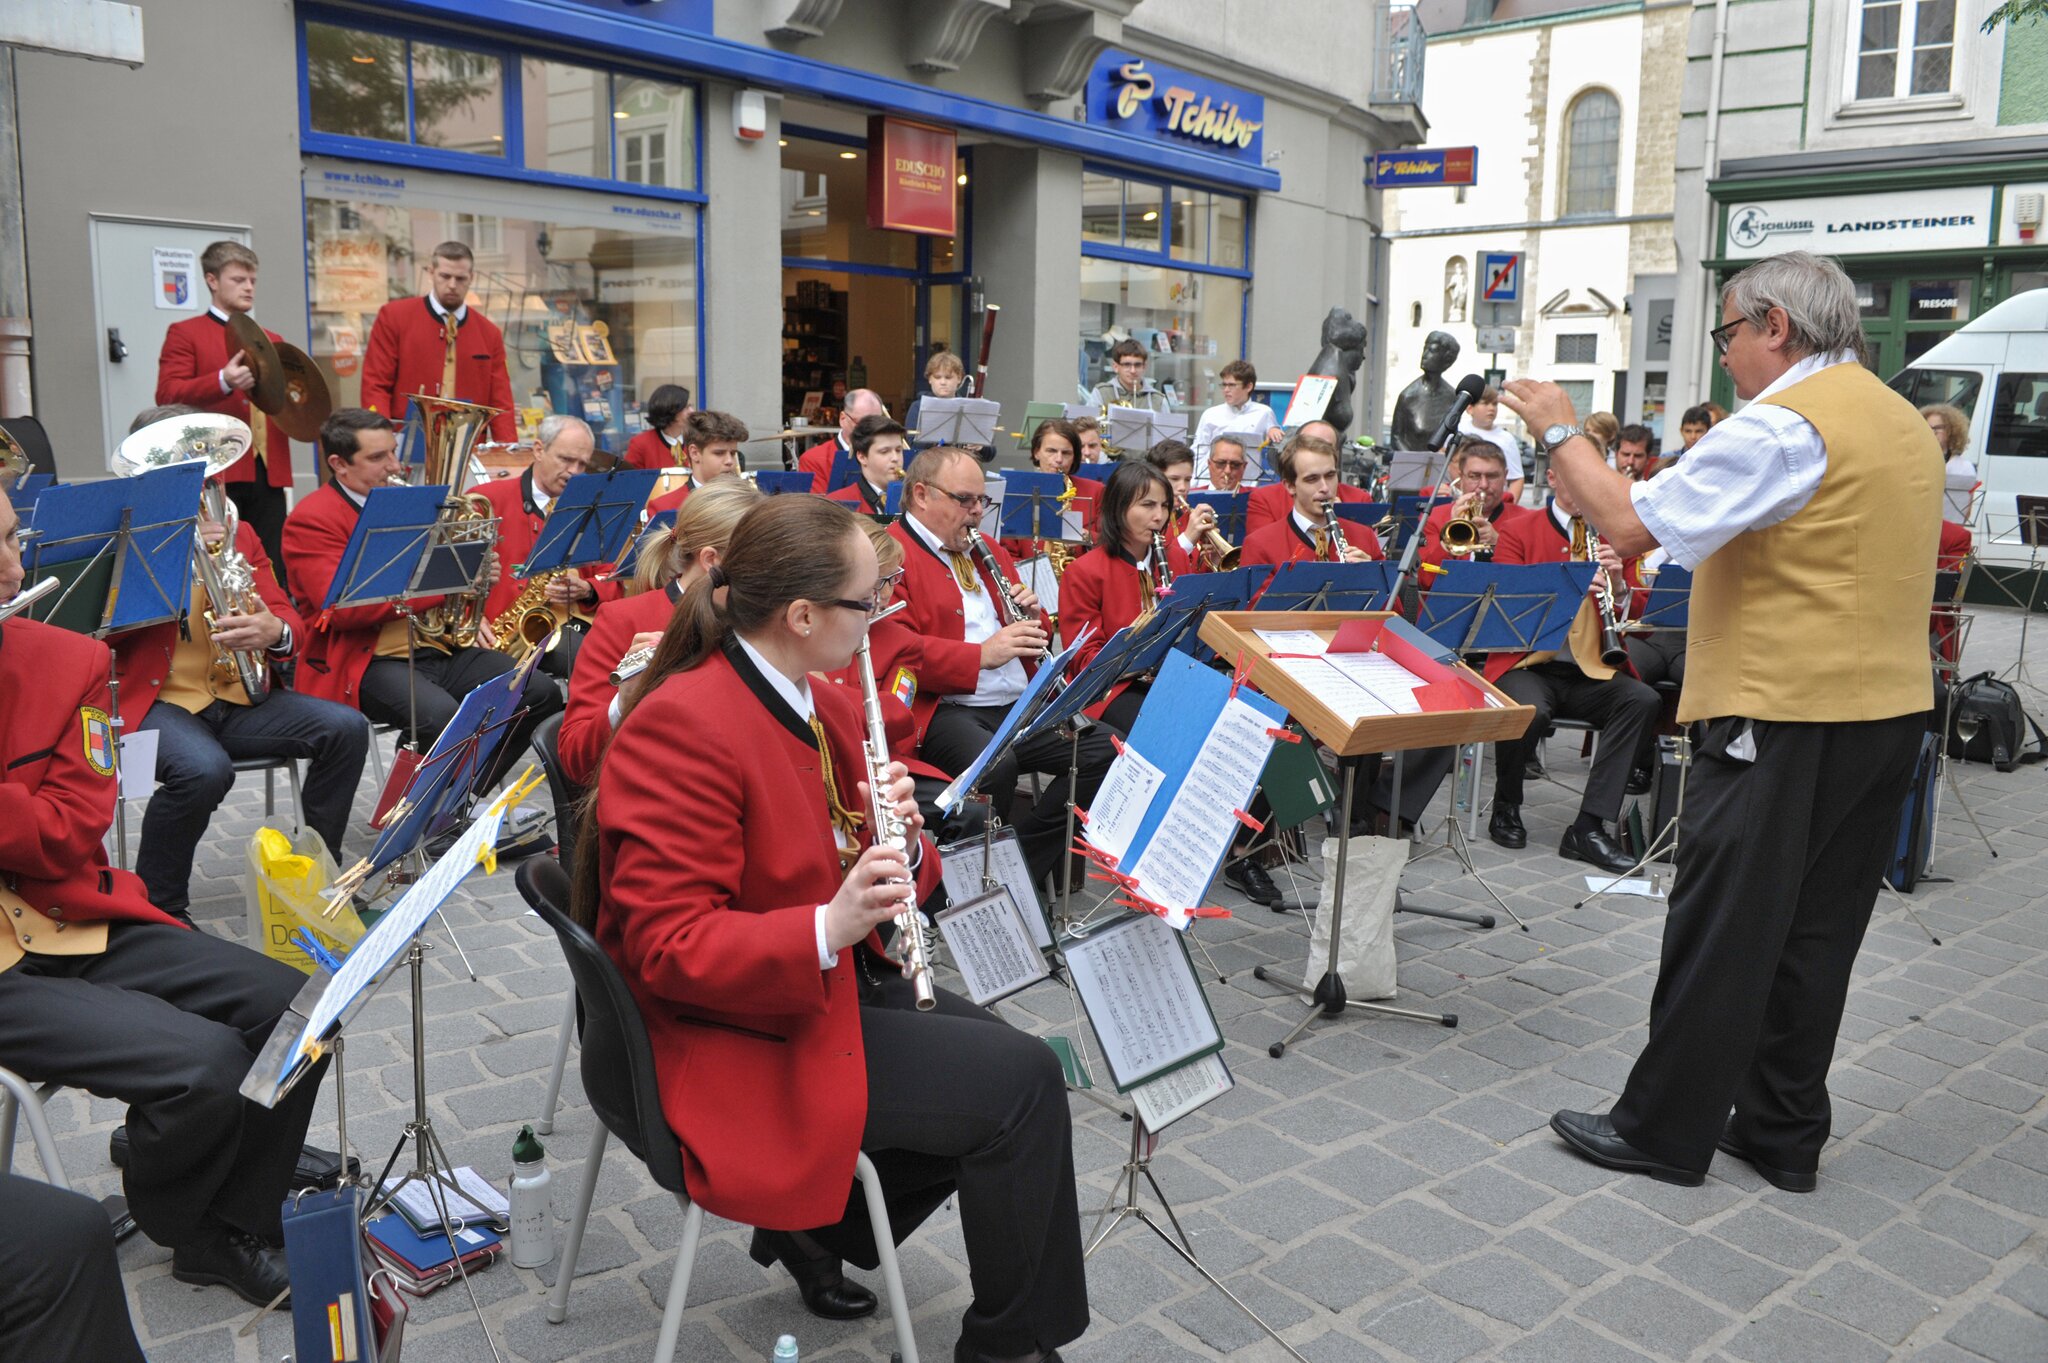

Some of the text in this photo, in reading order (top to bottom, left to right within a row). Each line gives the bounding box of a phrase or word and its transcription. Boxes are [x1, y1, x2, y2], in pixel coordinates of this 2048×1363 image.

[1164, 86, 1263, 149] Tchibo
[895, 158, 945, 178] EDUSCHO
[1394, 161, 1441, 176] Tchibo
[324, 171, 405, 189] www.tchibo.at
[612, 205, 682, 220] www.eduscho.at
[1760, 215, 1975, 234] SCHLÜSSEL LANDSTEINER
[154, 250, 193, 259] Plakatieren
[159, 260, 190, 268] verboten
[1918, 298, 1959, 309] TRESORE
